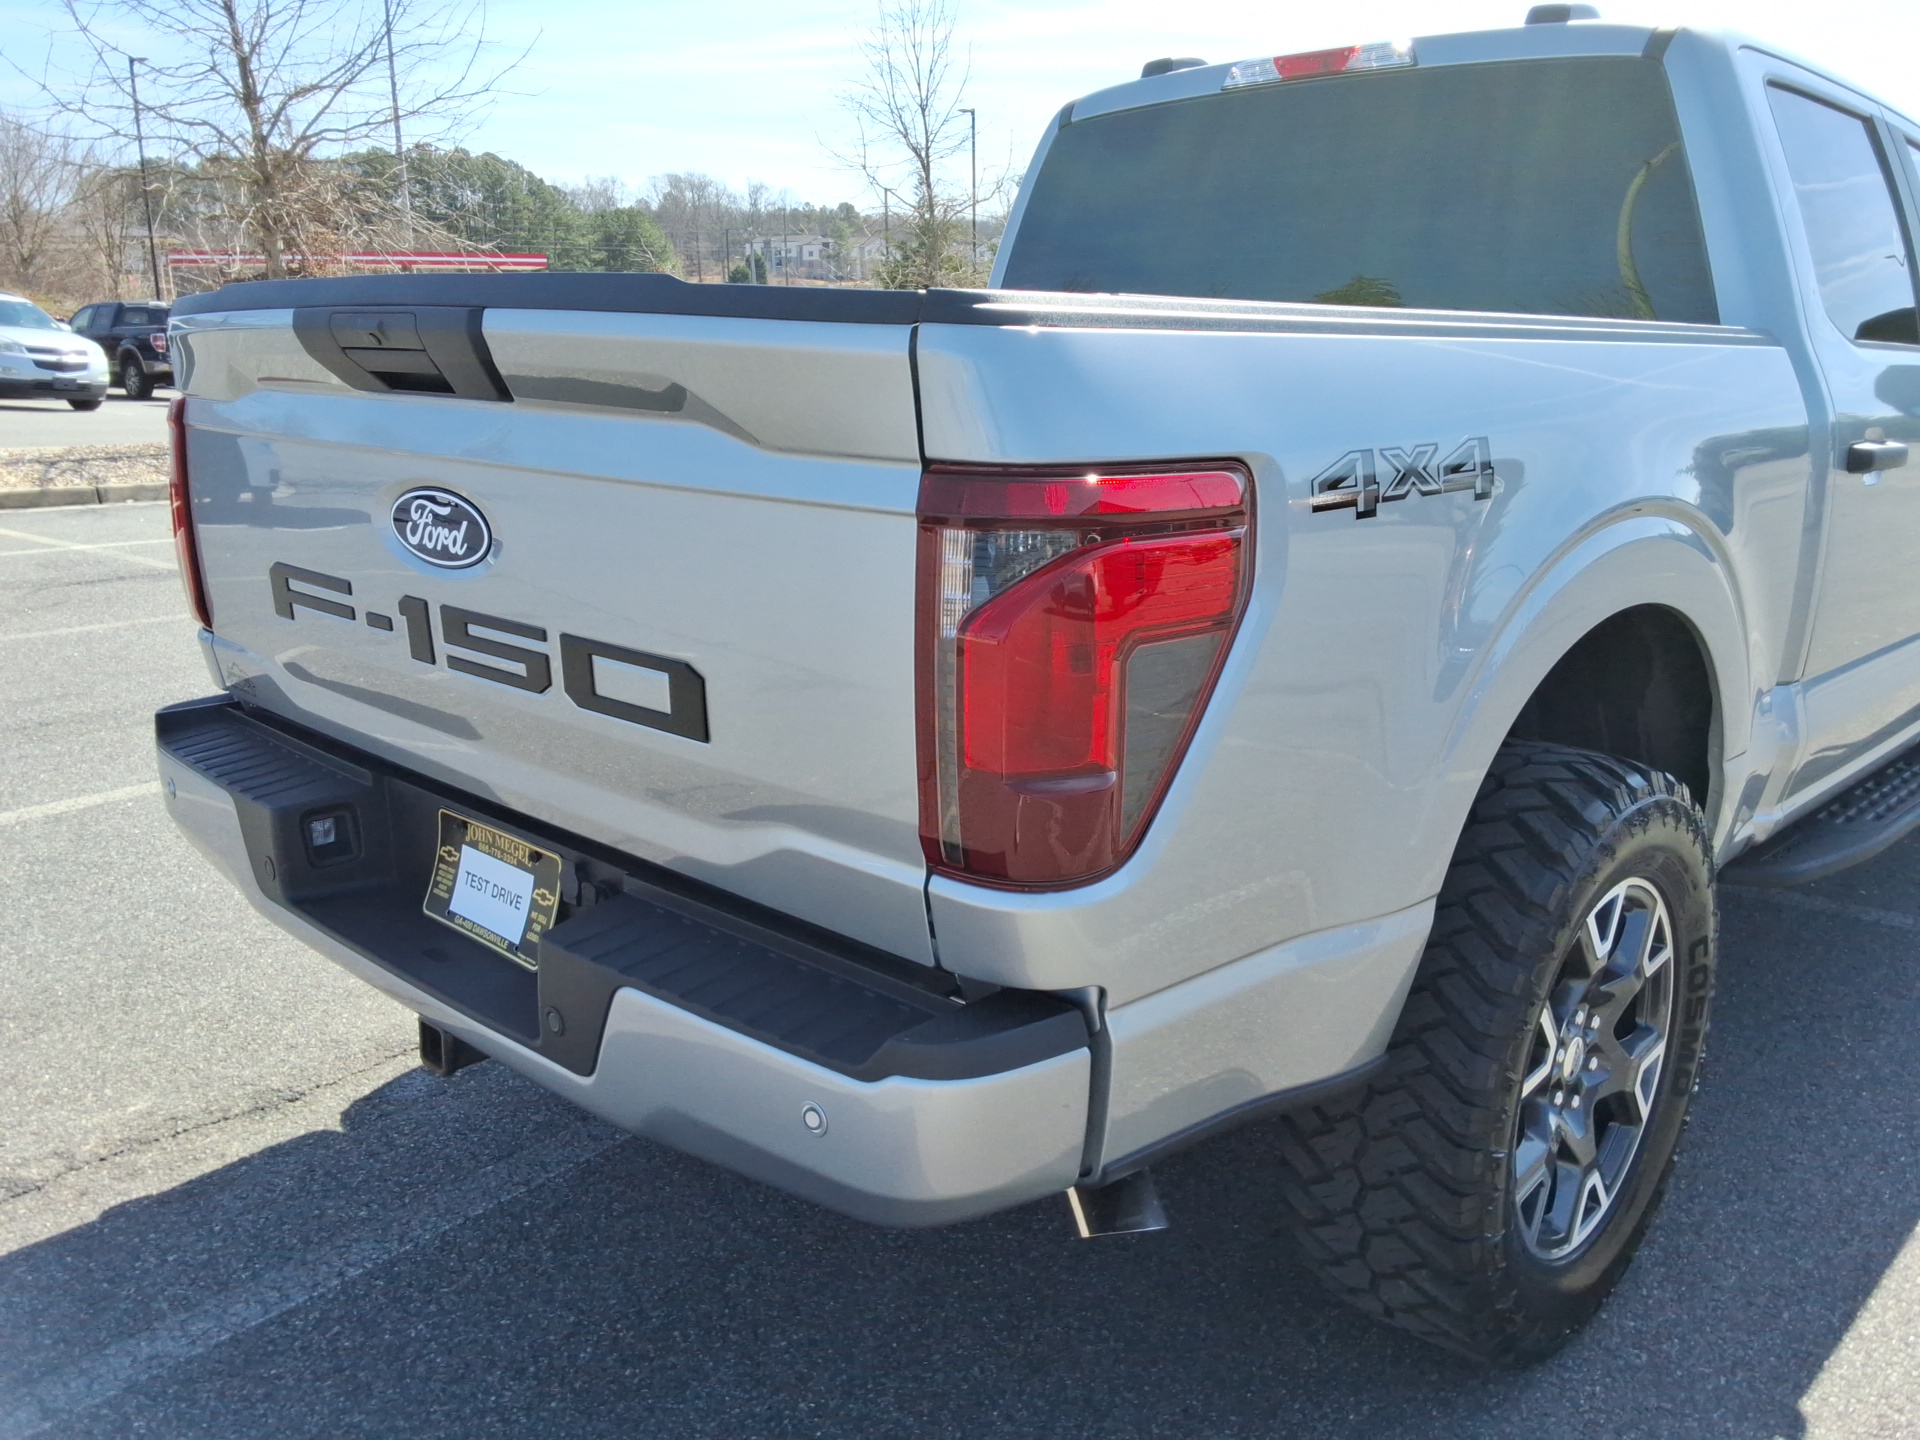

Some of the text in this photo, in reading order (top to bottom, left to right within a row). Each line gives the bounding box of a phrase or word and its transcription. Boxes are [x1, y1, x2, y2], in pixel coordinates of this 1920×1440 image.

[1310, 436, 1495, 520] 4X4
[405, 499, 468, 557] Ford
[269, 561, 711, 743] F-150
[466, 823, 532, 867] JOHN MEGEL
[465, 870, 490, 895] TEST
[491, 883, 522, 911] DRIVE
[472, 924, 509, 949] DAWSONVILLE
[1672, 934, 1709, 1098] COSMO
